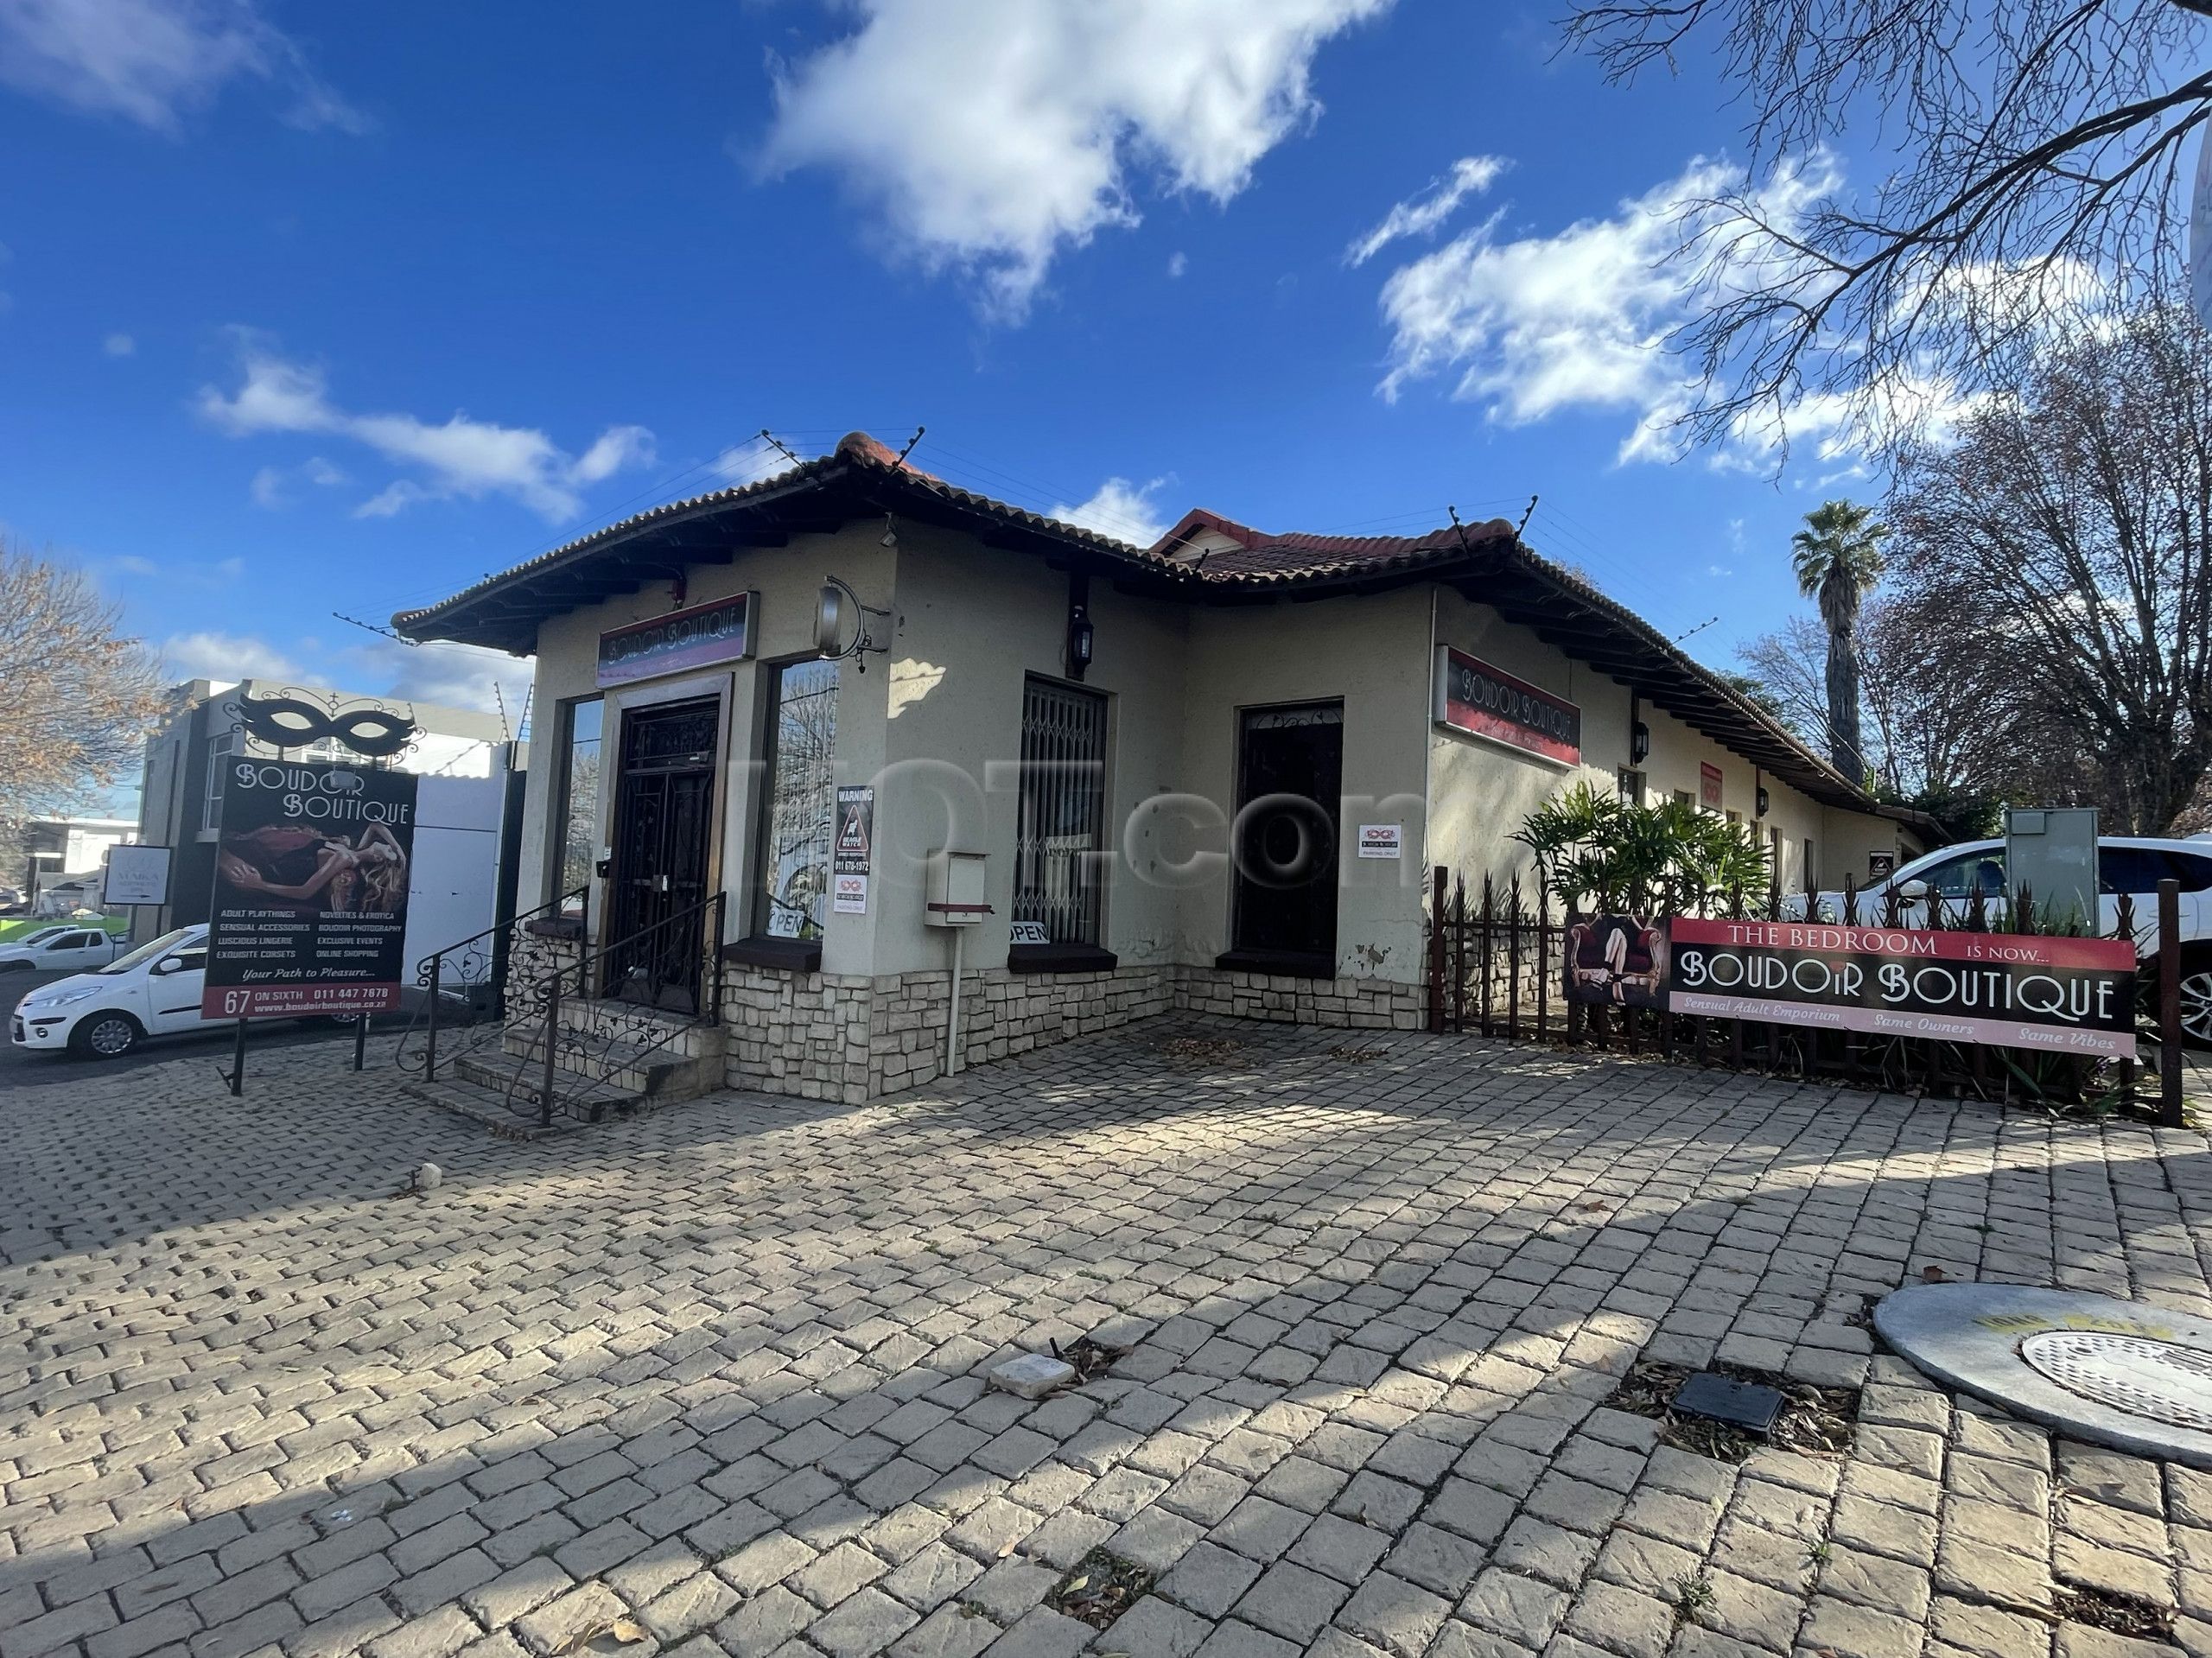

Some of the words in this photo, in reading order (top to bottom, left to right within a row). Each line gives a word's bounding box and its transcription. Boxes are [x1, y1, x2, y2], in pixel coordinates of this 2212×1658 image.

[668, 607, 735, 648] BOUTIQUE
[283, 793, 409, 826] BOUTIQUE
[838, 789, 873, 802] WARNING
[1728, 924, 1779, 945] THE
[1790, 928, 1937, 955] BEDROOM
[1967, 945, 1982, 957] IS
[1988, 947, 2050, 963] NOW...
[243, 969, 271, 981] Your
[274, 968, 302, 977] Path
[320, 968, 375, 977] Pleasure...
[1681, 950, 1864, 997] BOUDOIR
[1878, 963, 2114, 1022] BOUTIQUE
[225, 990, 251, 1013] 67
[255, 992, 270, 1001] ON
[272, 991, 302, 1001] SIXTH
[314, 989, 334, 1000] 011
[338, 989, 358, 998] 447
[362, 988, 388, 997] 7878
[255, 1001, 386, 1013] www.boudoirboutique.co.za
[1683, 996, 1730, 1012] Sensual
[1732, 1001, 1770, 1016] Adult
[1772, 1005, 1840, 1023] Emporium
[1874, 1013, 1912, 1030] Same
[1917, 1018, 1975, 1035] Owners
[2018, 1027, 2064, 1045] Same
[2069, 1032, 2116, 1051] Vibes
